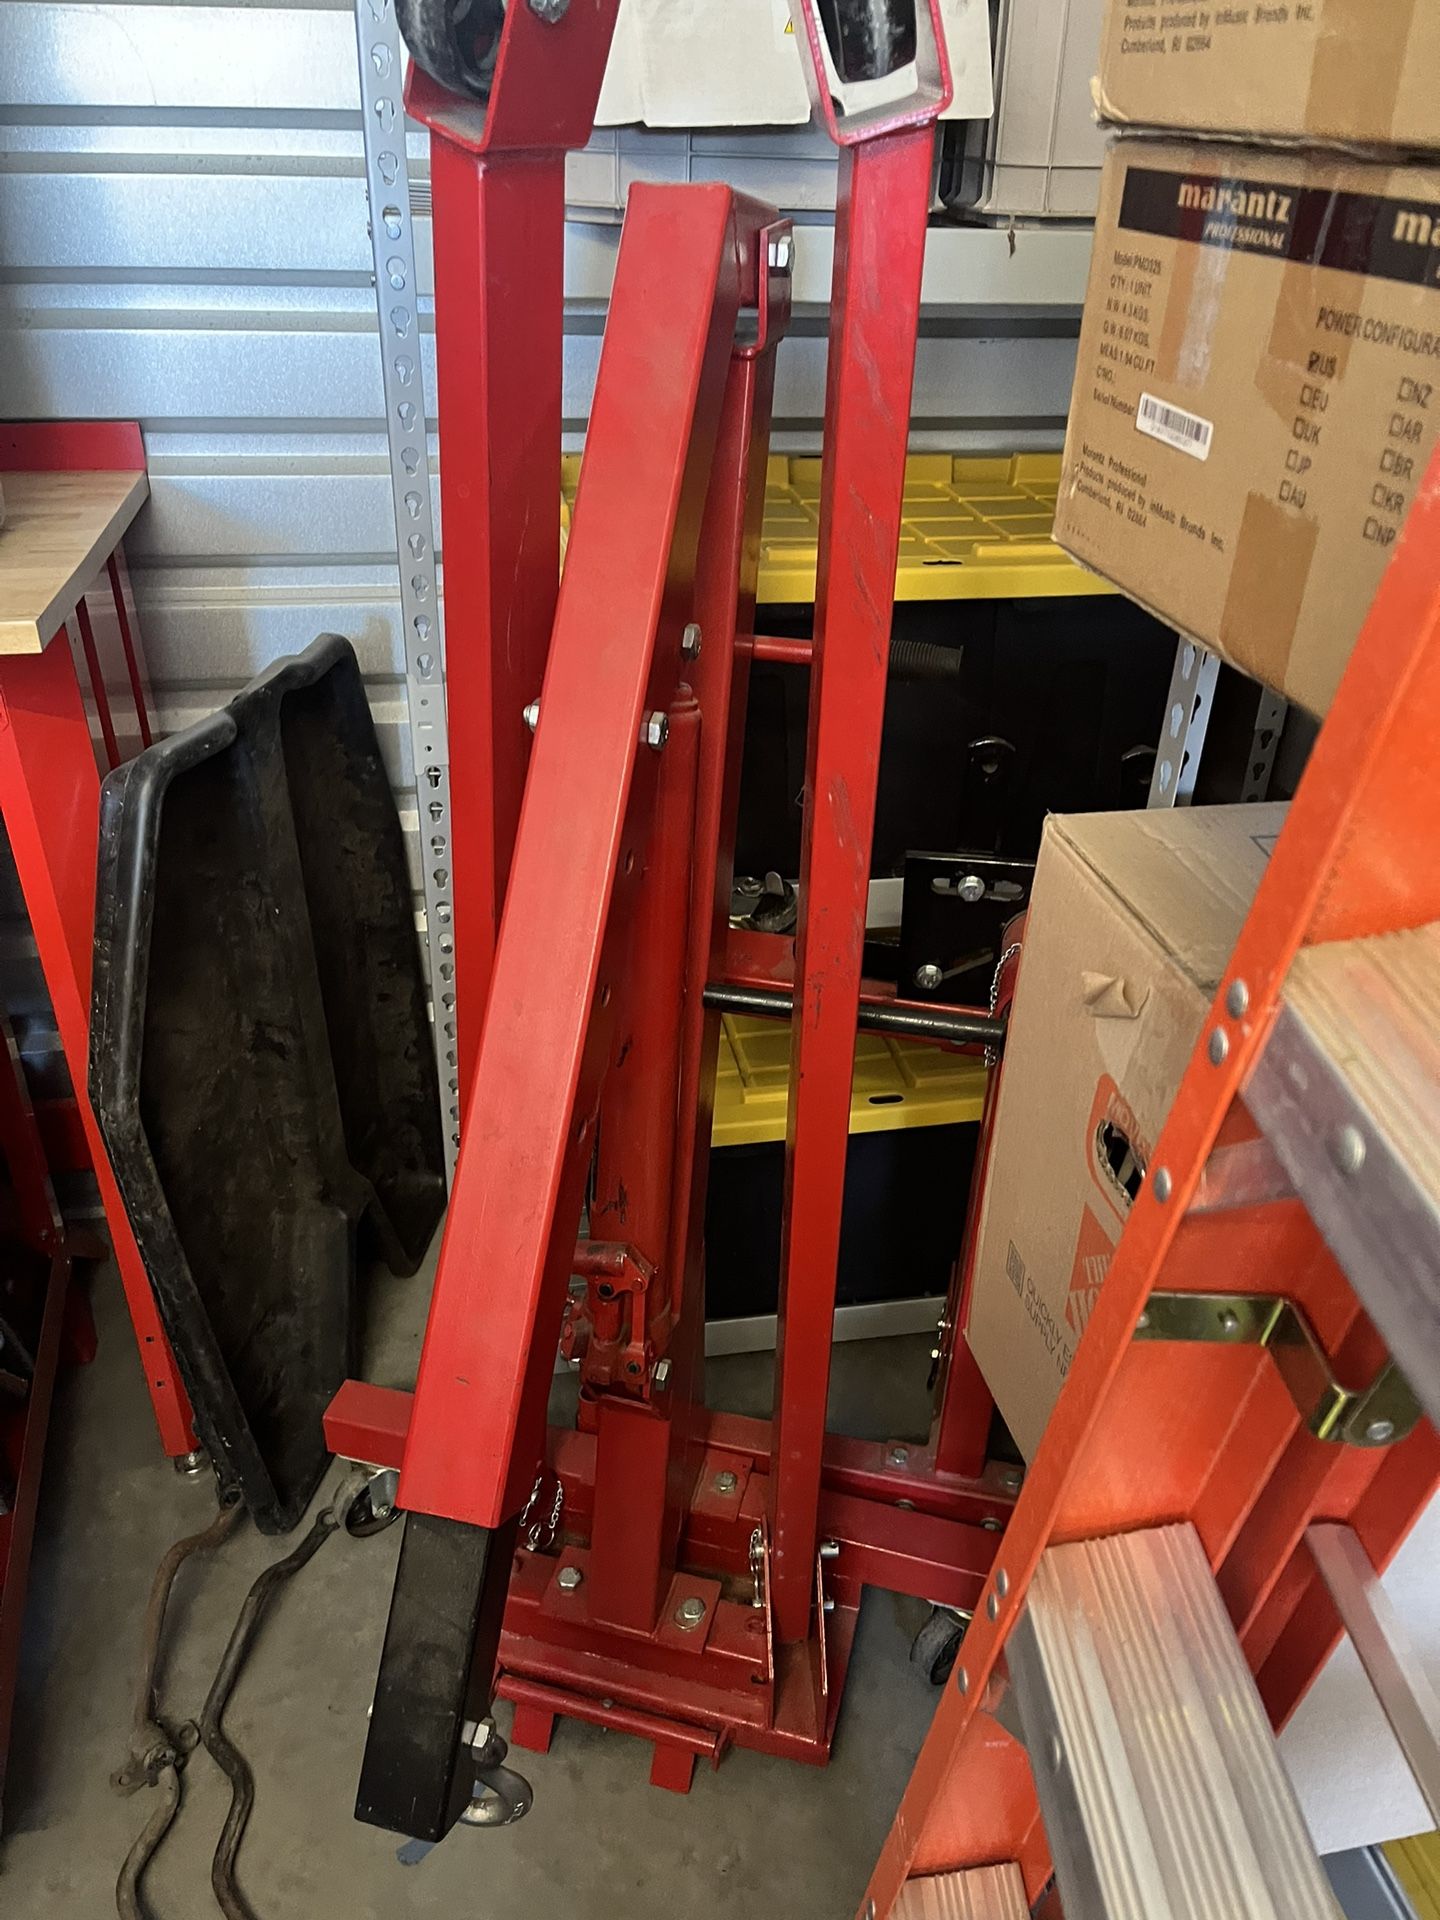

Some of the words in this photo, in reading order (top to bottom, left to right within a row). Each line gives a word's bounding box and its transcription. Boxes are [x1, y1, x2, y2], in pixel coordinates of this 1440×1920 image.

[1178, 182, 1292, 222] marantz
[1203, 220, 1286, 250] PROFESSIONAL
[1315, 306, 1362, 339] POWER
[1311, 387, 1329, 413] EU
[1024, 1293, 1056, 1356] SUPPLY
[1026, 1276, 1063, 1346] QUICKLY
